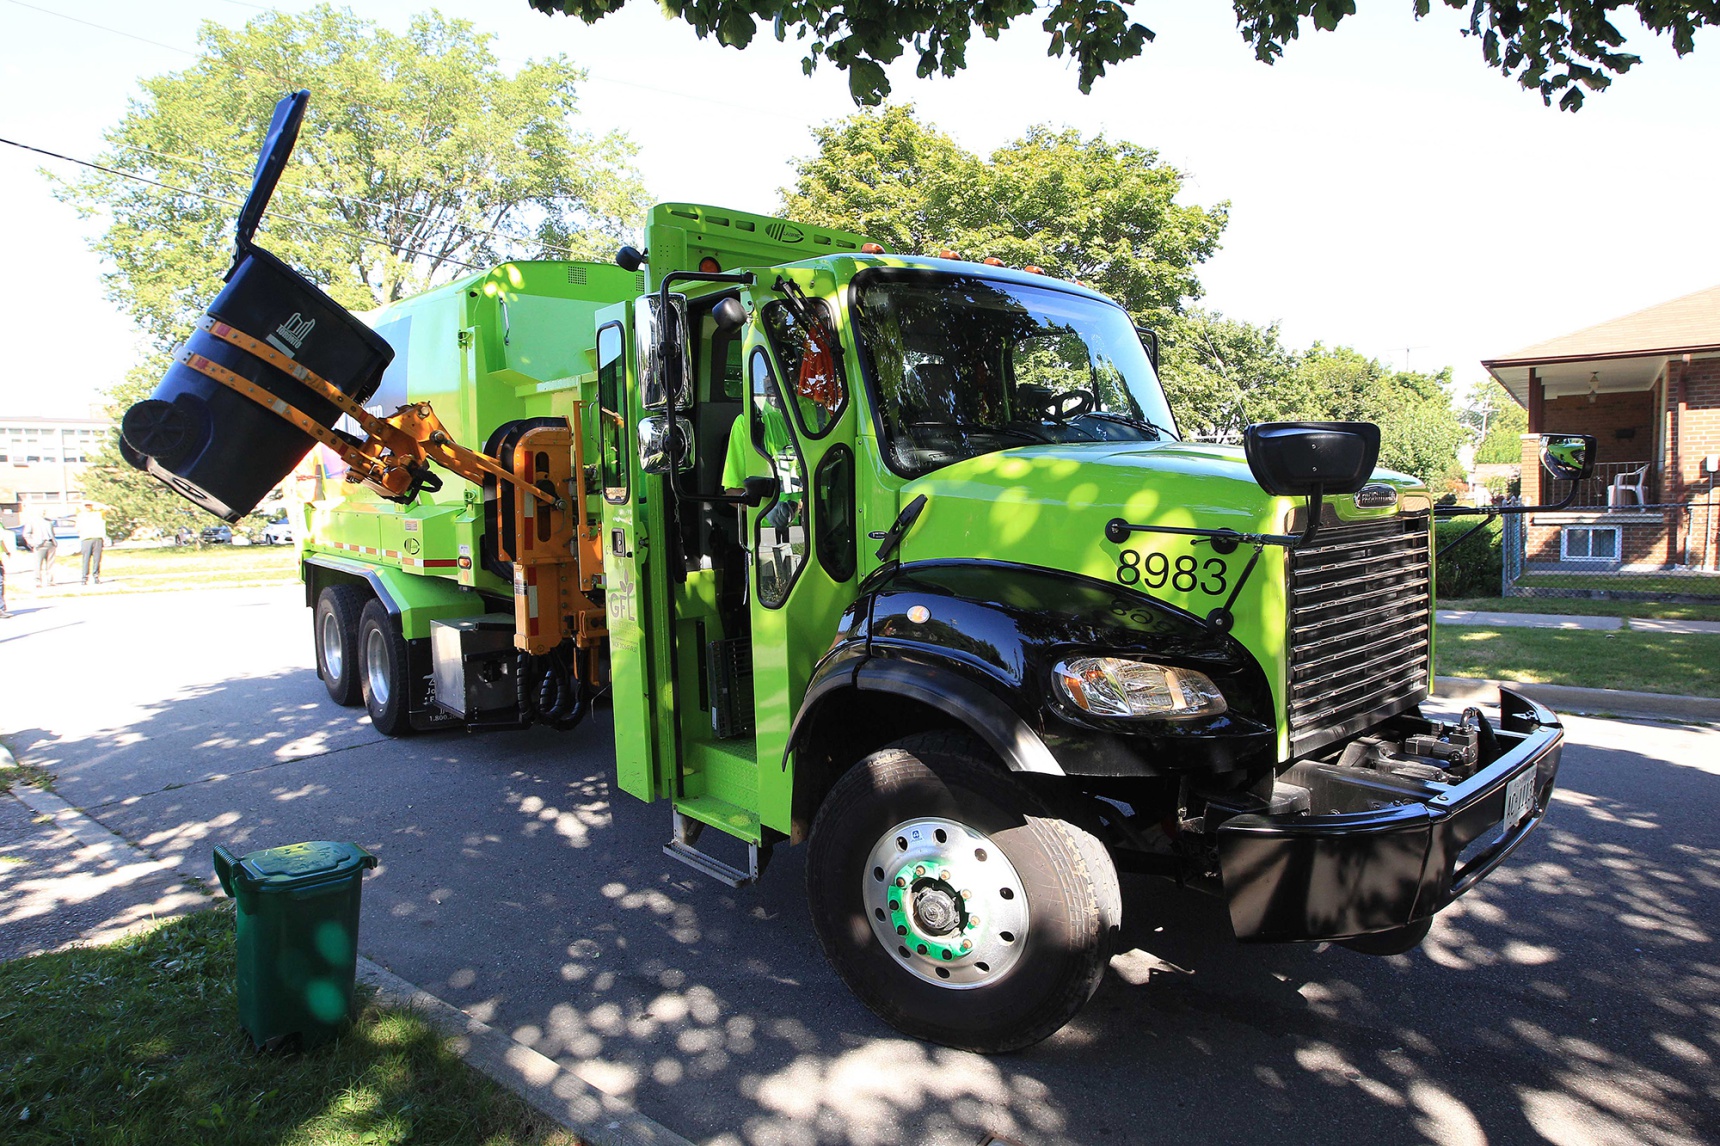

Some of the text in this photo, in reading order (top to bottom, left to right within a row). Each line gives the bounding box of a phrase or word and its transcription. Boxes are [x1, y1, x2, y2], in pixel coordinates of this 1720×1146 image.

[276, 324, 302, 349] TORONTO
[1117, 549, 1227, 596] 8983
[610, 592, 636, 622] GFL
